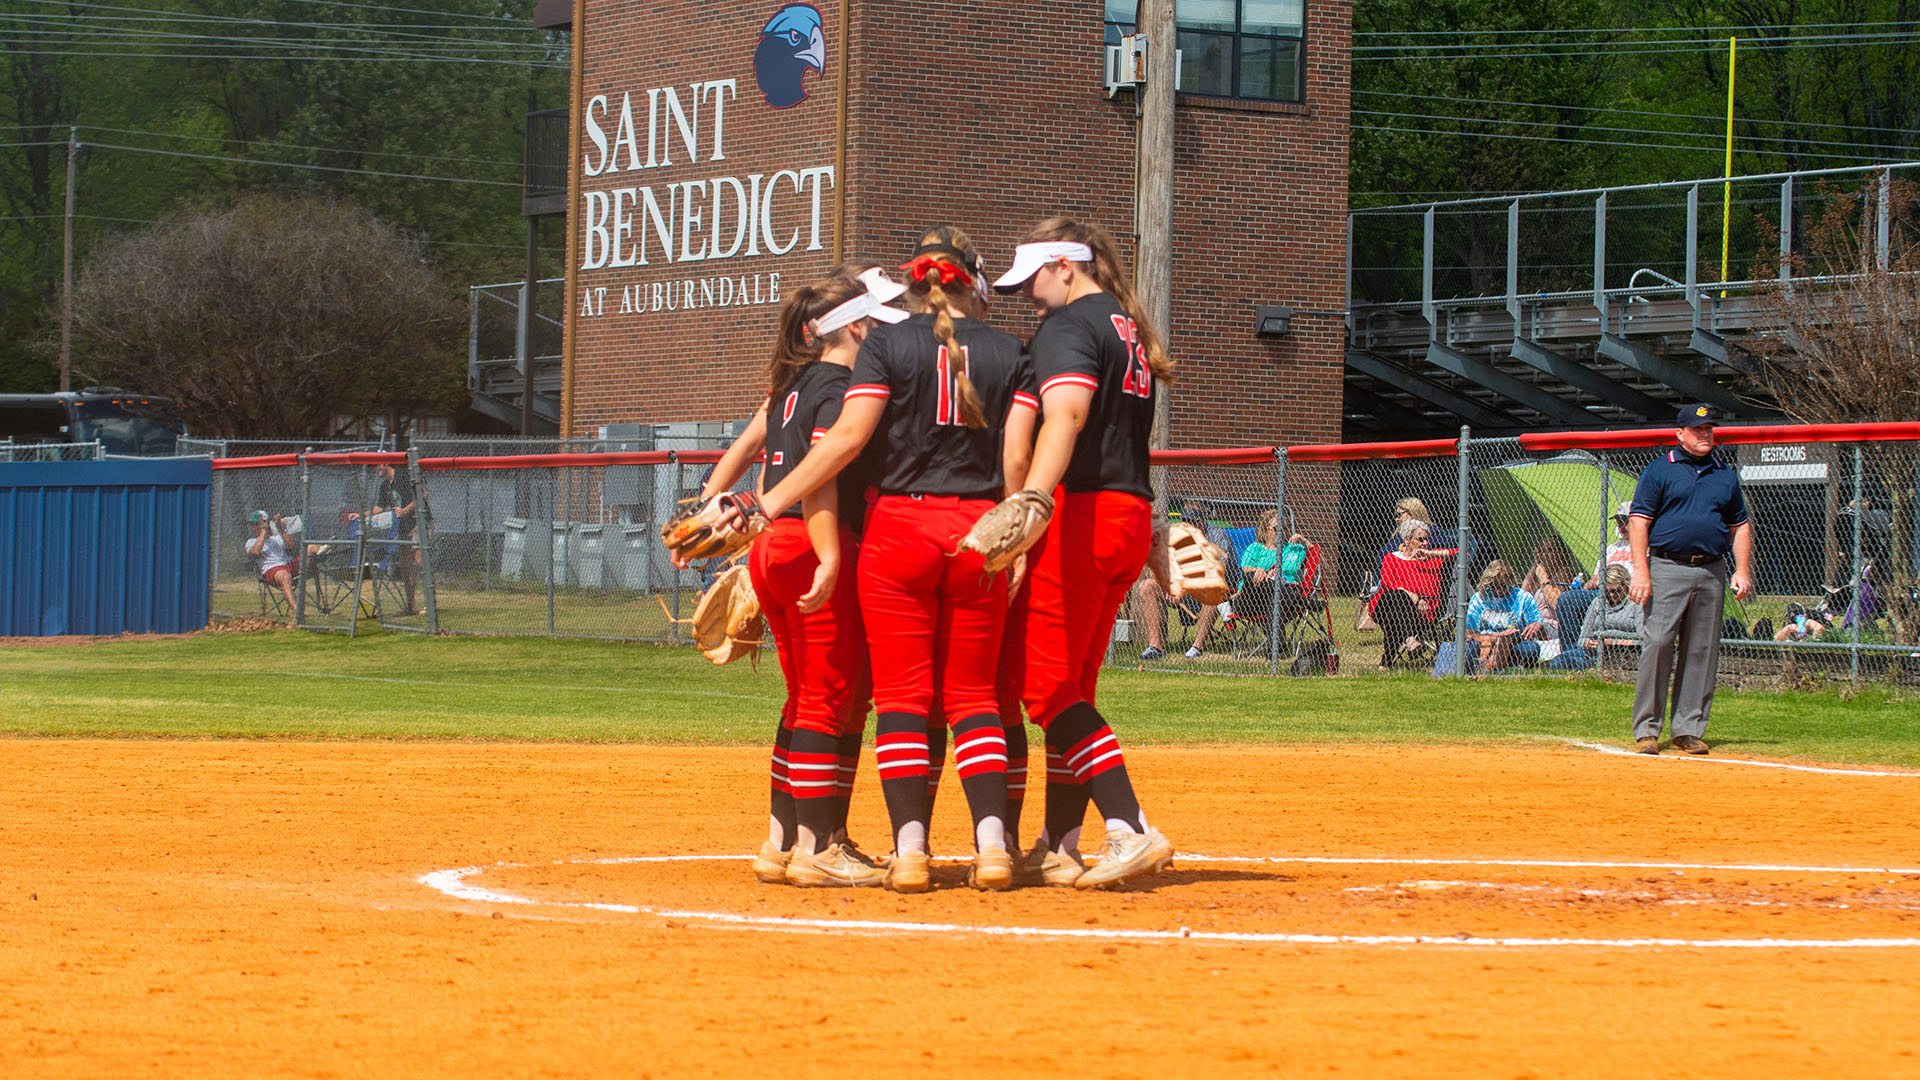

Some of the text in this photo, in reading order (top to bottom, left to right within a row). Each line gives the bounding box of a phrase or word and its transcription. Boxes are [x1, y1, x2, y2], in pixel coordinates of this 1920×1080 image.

[584, 78, 737, 177] SAINT
[580, 165, 835, 270] BENEDICT
[580, 272, 781, 317] AT AUBURNDALE
[1760, 445, 1807, 462] RESTROOMS
